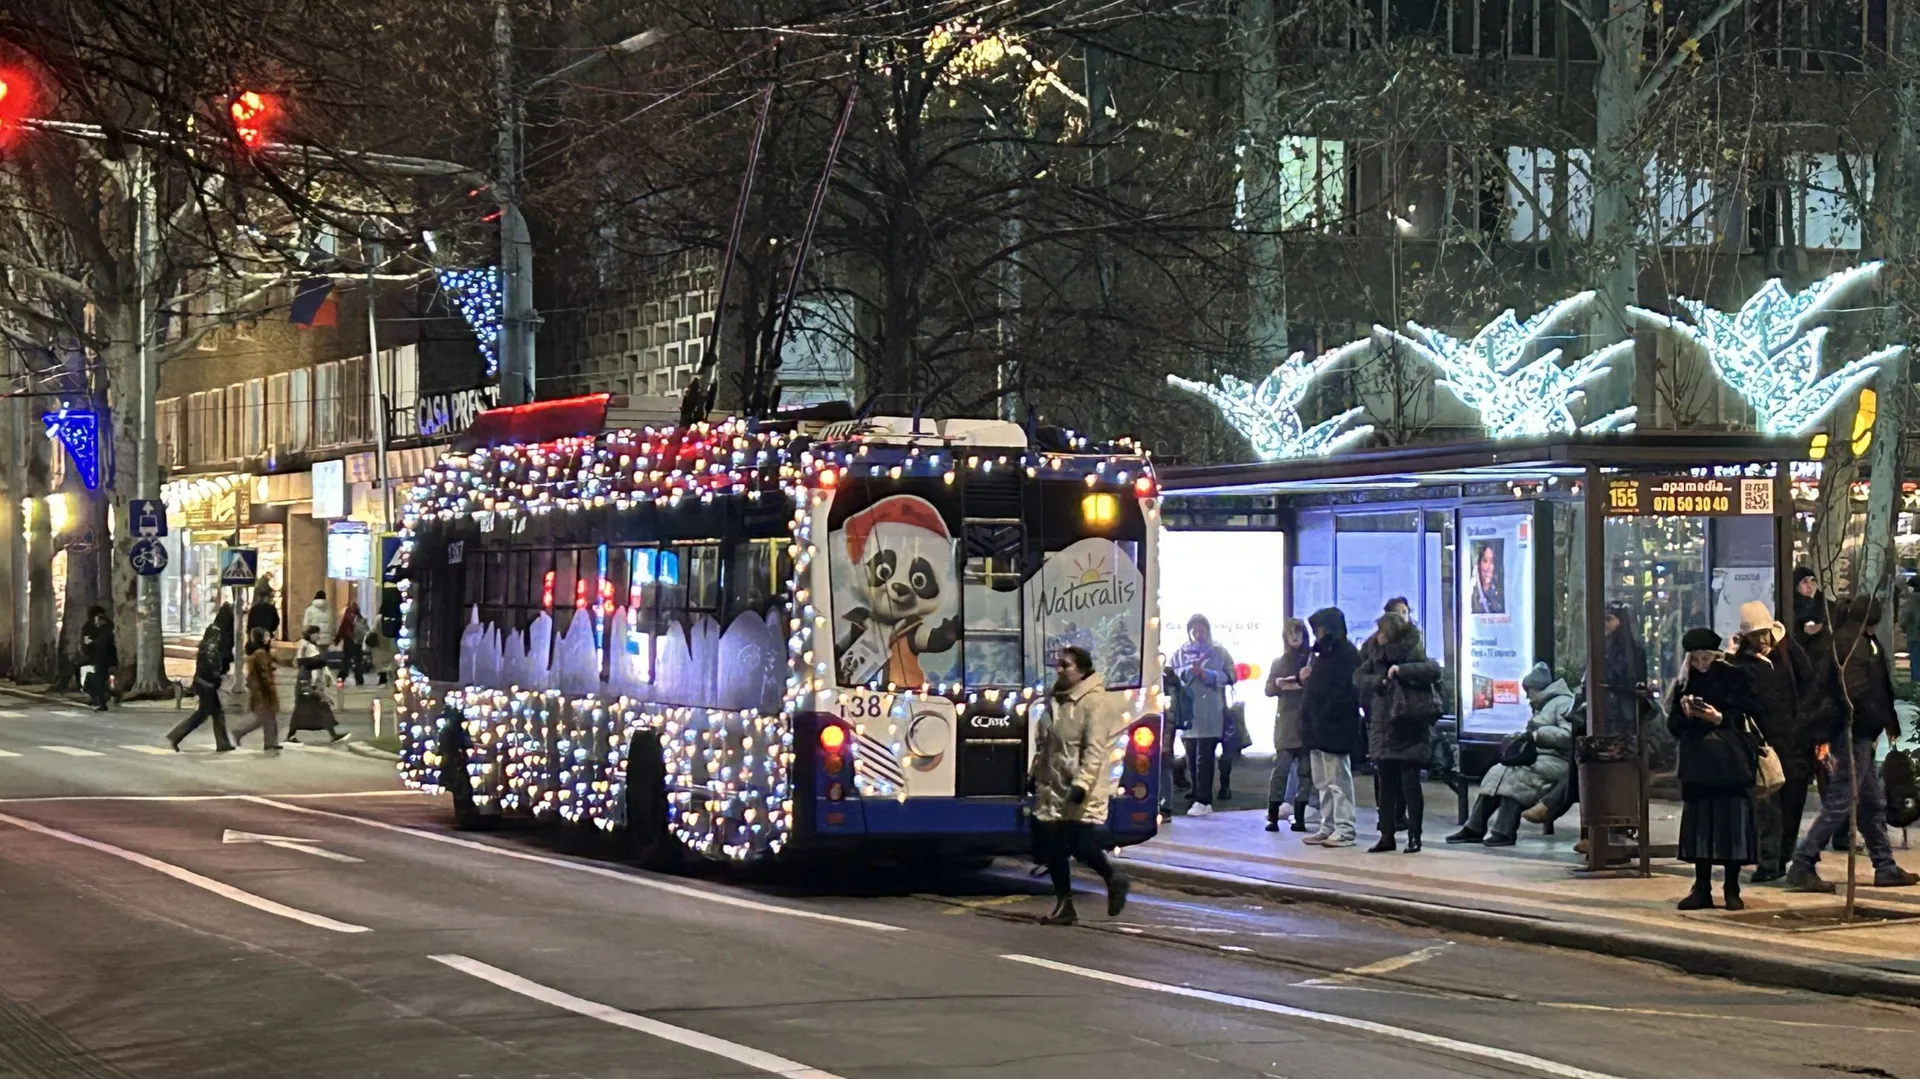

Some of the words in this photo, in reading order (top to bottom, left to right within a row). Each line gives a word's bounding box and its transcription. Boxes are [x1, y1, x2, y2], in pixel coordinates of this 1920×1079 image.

[418, 395, 451, 435] CASA
[1609, 488, 1637, 507] 155
[1677, 497, 1693, 511] 50
[1695, 497, 1711, 511] 30
[1713, 496, 1729, 511] 40
[1036, 575, 1134, 621] Naturalis
